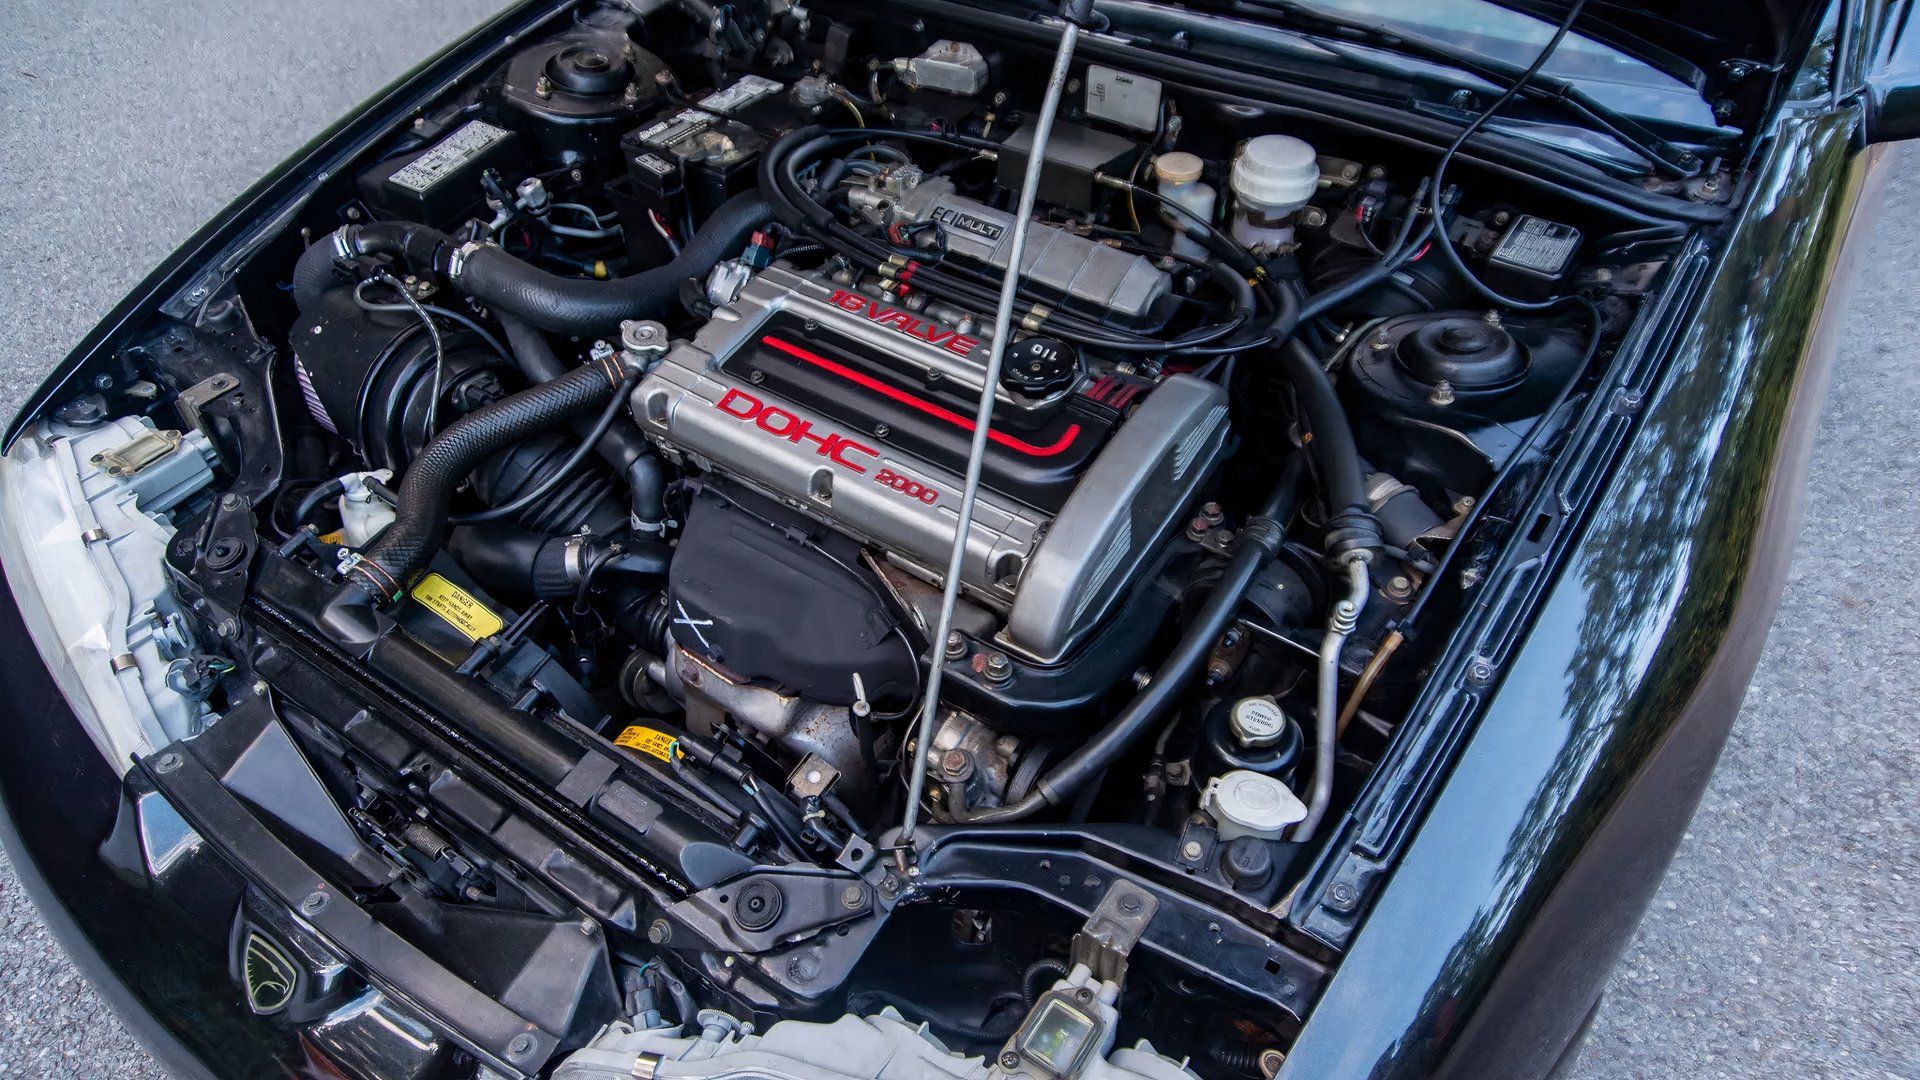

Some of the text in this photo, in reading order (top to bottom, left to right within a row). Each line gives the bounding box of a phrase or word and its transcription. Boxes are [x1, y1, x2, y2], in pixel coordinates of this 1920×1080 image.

[957, 216, 1001, 238] MULTI
[829, 290, 979, 357] 16 VALVE
[1031, 344, 1057, 361] OIL
[716, 388, 939, 505] DOHC 2000
[452, 591, 474, 609] DANGER
